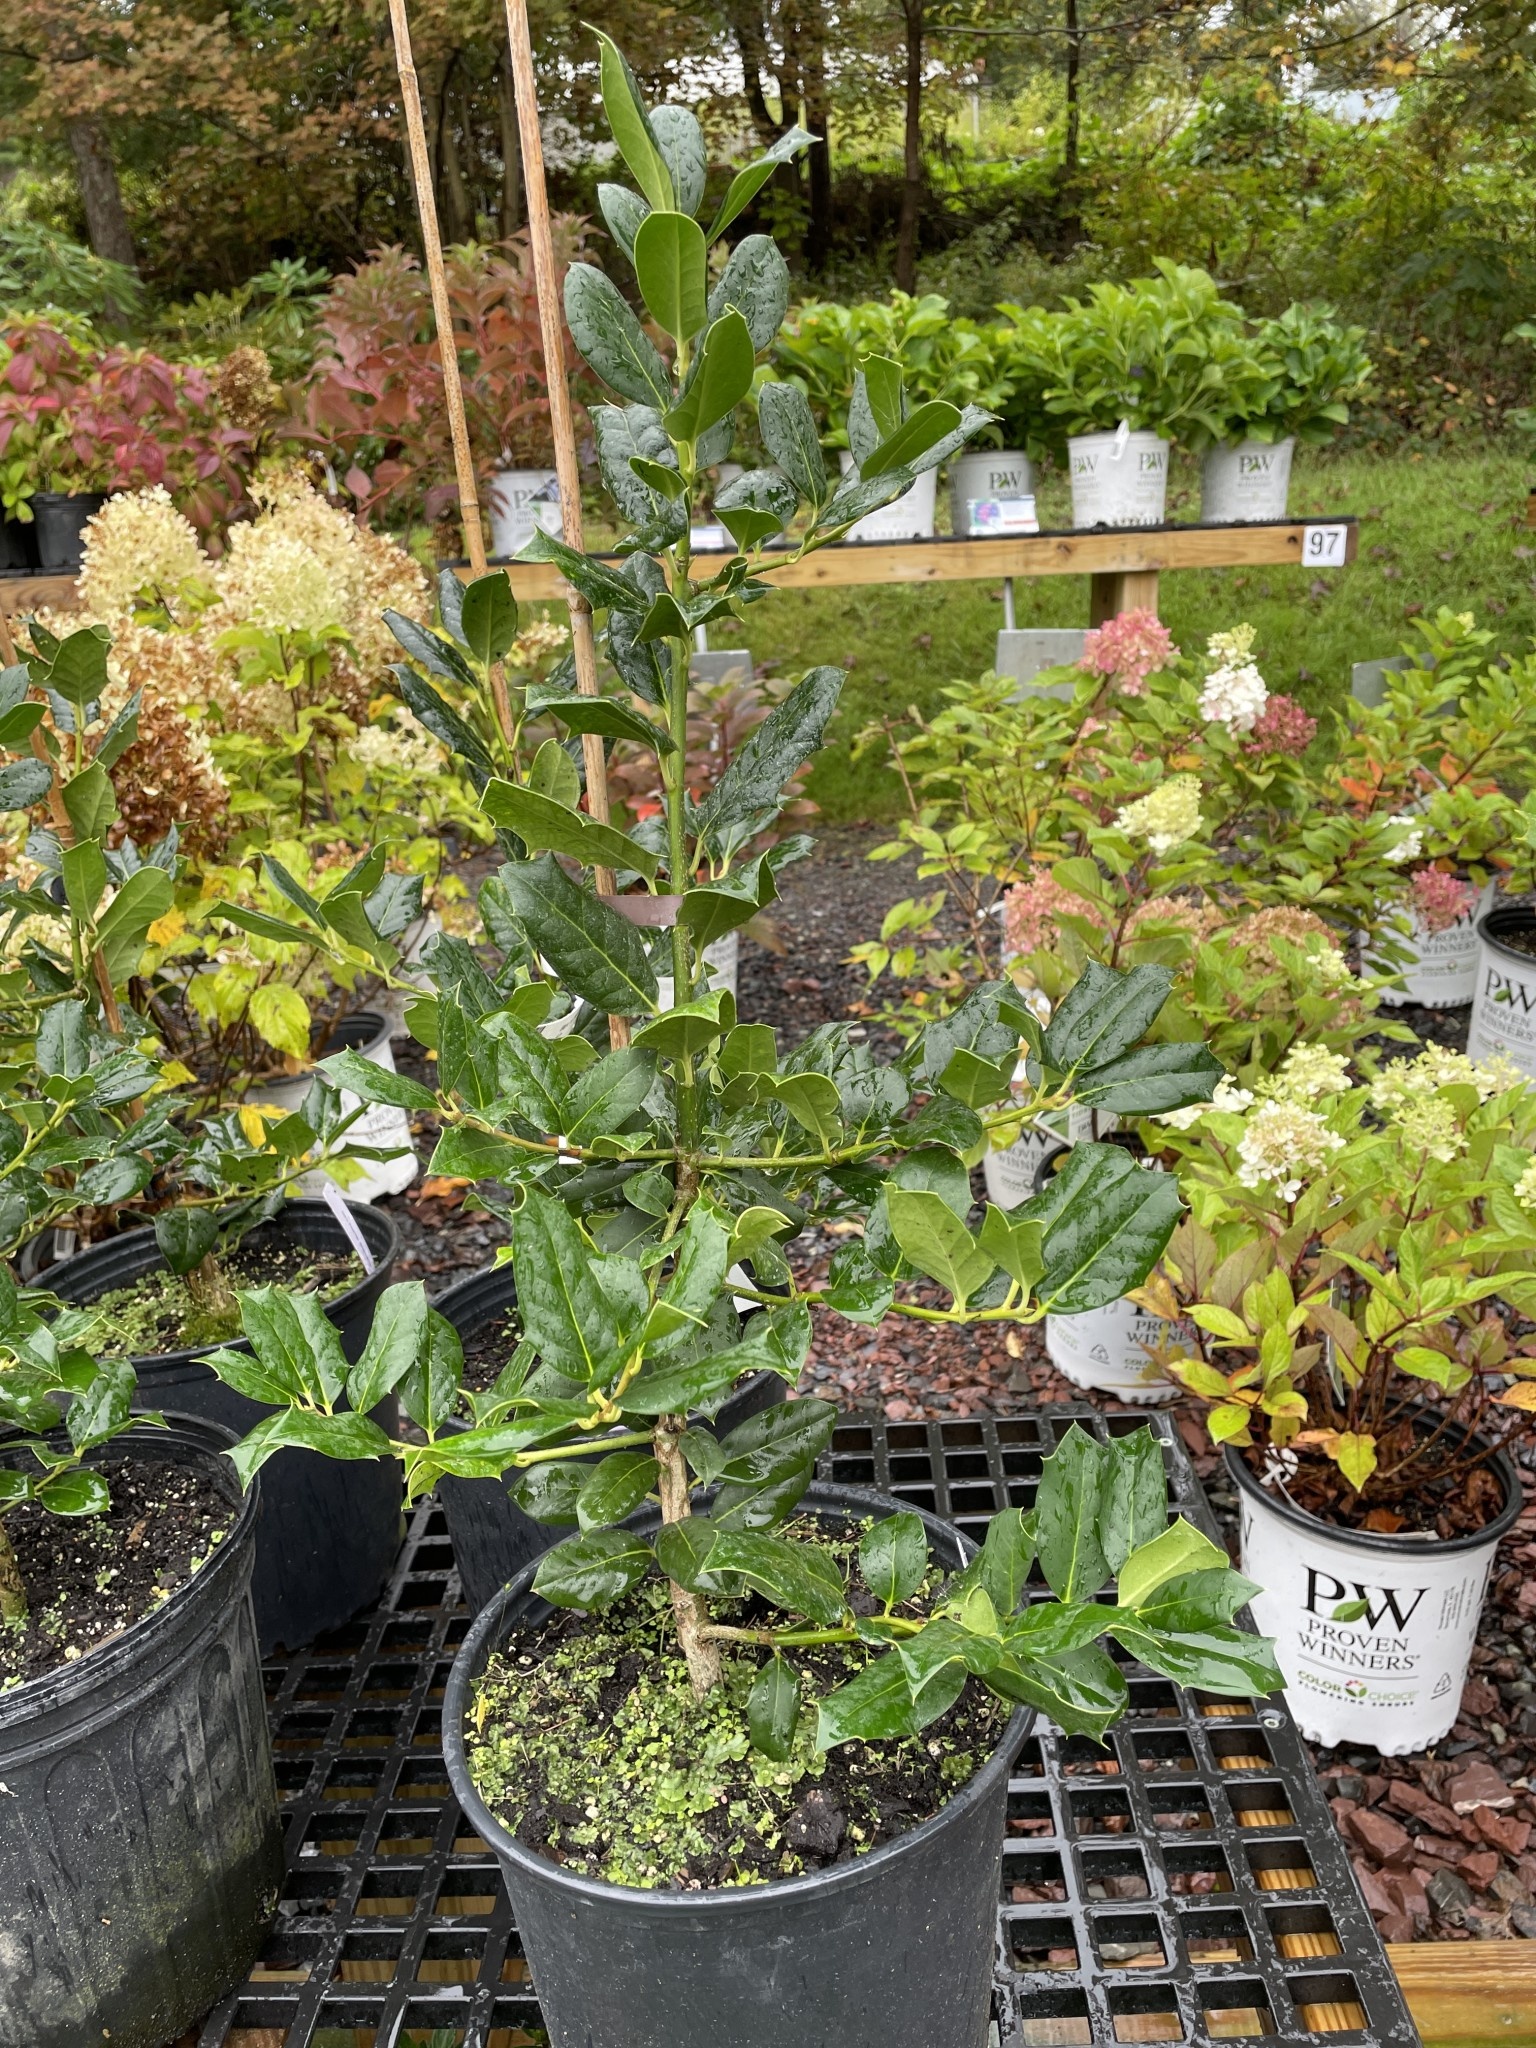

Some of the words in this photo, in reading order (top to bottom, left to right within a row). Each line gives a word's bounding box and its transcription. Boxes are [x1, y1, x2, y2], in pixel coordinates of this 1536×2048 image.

[1139, 452, 1166, 471] PW
[1240, 454, 1274, 473] PW
[989, 471, 1023, 490] PW
[513, 489, 534, 510] P
[1310, 531, 1339, 556] 97
[1301, 1563, 1431, 1632] PW
[1308, 1618, 1409, 1653] PROVEN
[1298, 1632, 1415, 1671] WINNERS
[1297, 1670, 1342, 1693] COLOR
